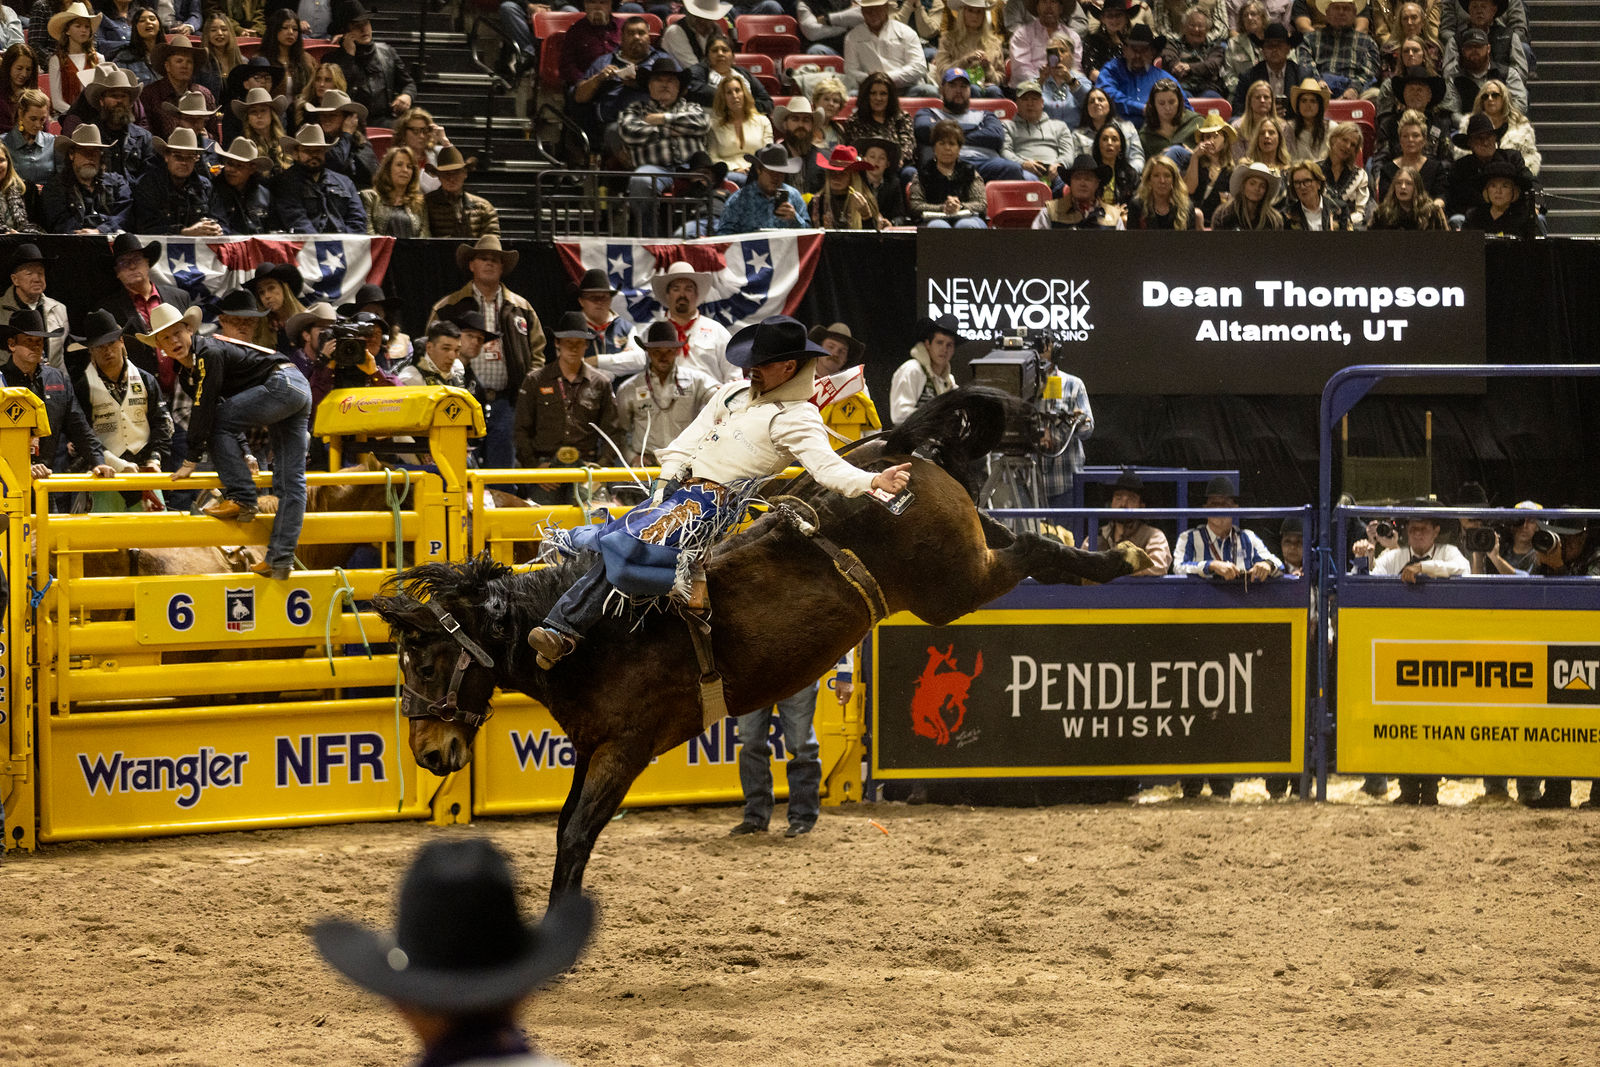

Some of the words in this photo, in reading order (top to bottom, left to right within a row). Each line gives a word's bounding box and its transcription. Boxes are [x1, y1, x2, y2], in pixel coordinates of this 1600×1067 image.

[928, 278, 1002, 304] NEW
[1004, 278, 1090, 304] YORK
[1142, 281, 1243, 307] Dean
[1255, 281, 1465, 313] Thompson
[1195, 319, 1352, 346] Altamont,
[1363, 319, 1409, 342] UT
[167, 593, 195, 631] 6
[286, 588, 313, 627] 6
[1004, 652, 1254, 718] PENDLETON
[1396, 660, 1534, 689] EMPIRE
[1553, 659, 1600, 691] CAT
[1062, 715, 1196, 739] WHISKY
[1373, 724, 1419, 740] MORE
[1422, 725, 1466, 741] THAN
[1470, 726, 1519, 742] GREAT
[78, 747, 249, 808] Wrangler
[275, 732, 387, 788] NFR
